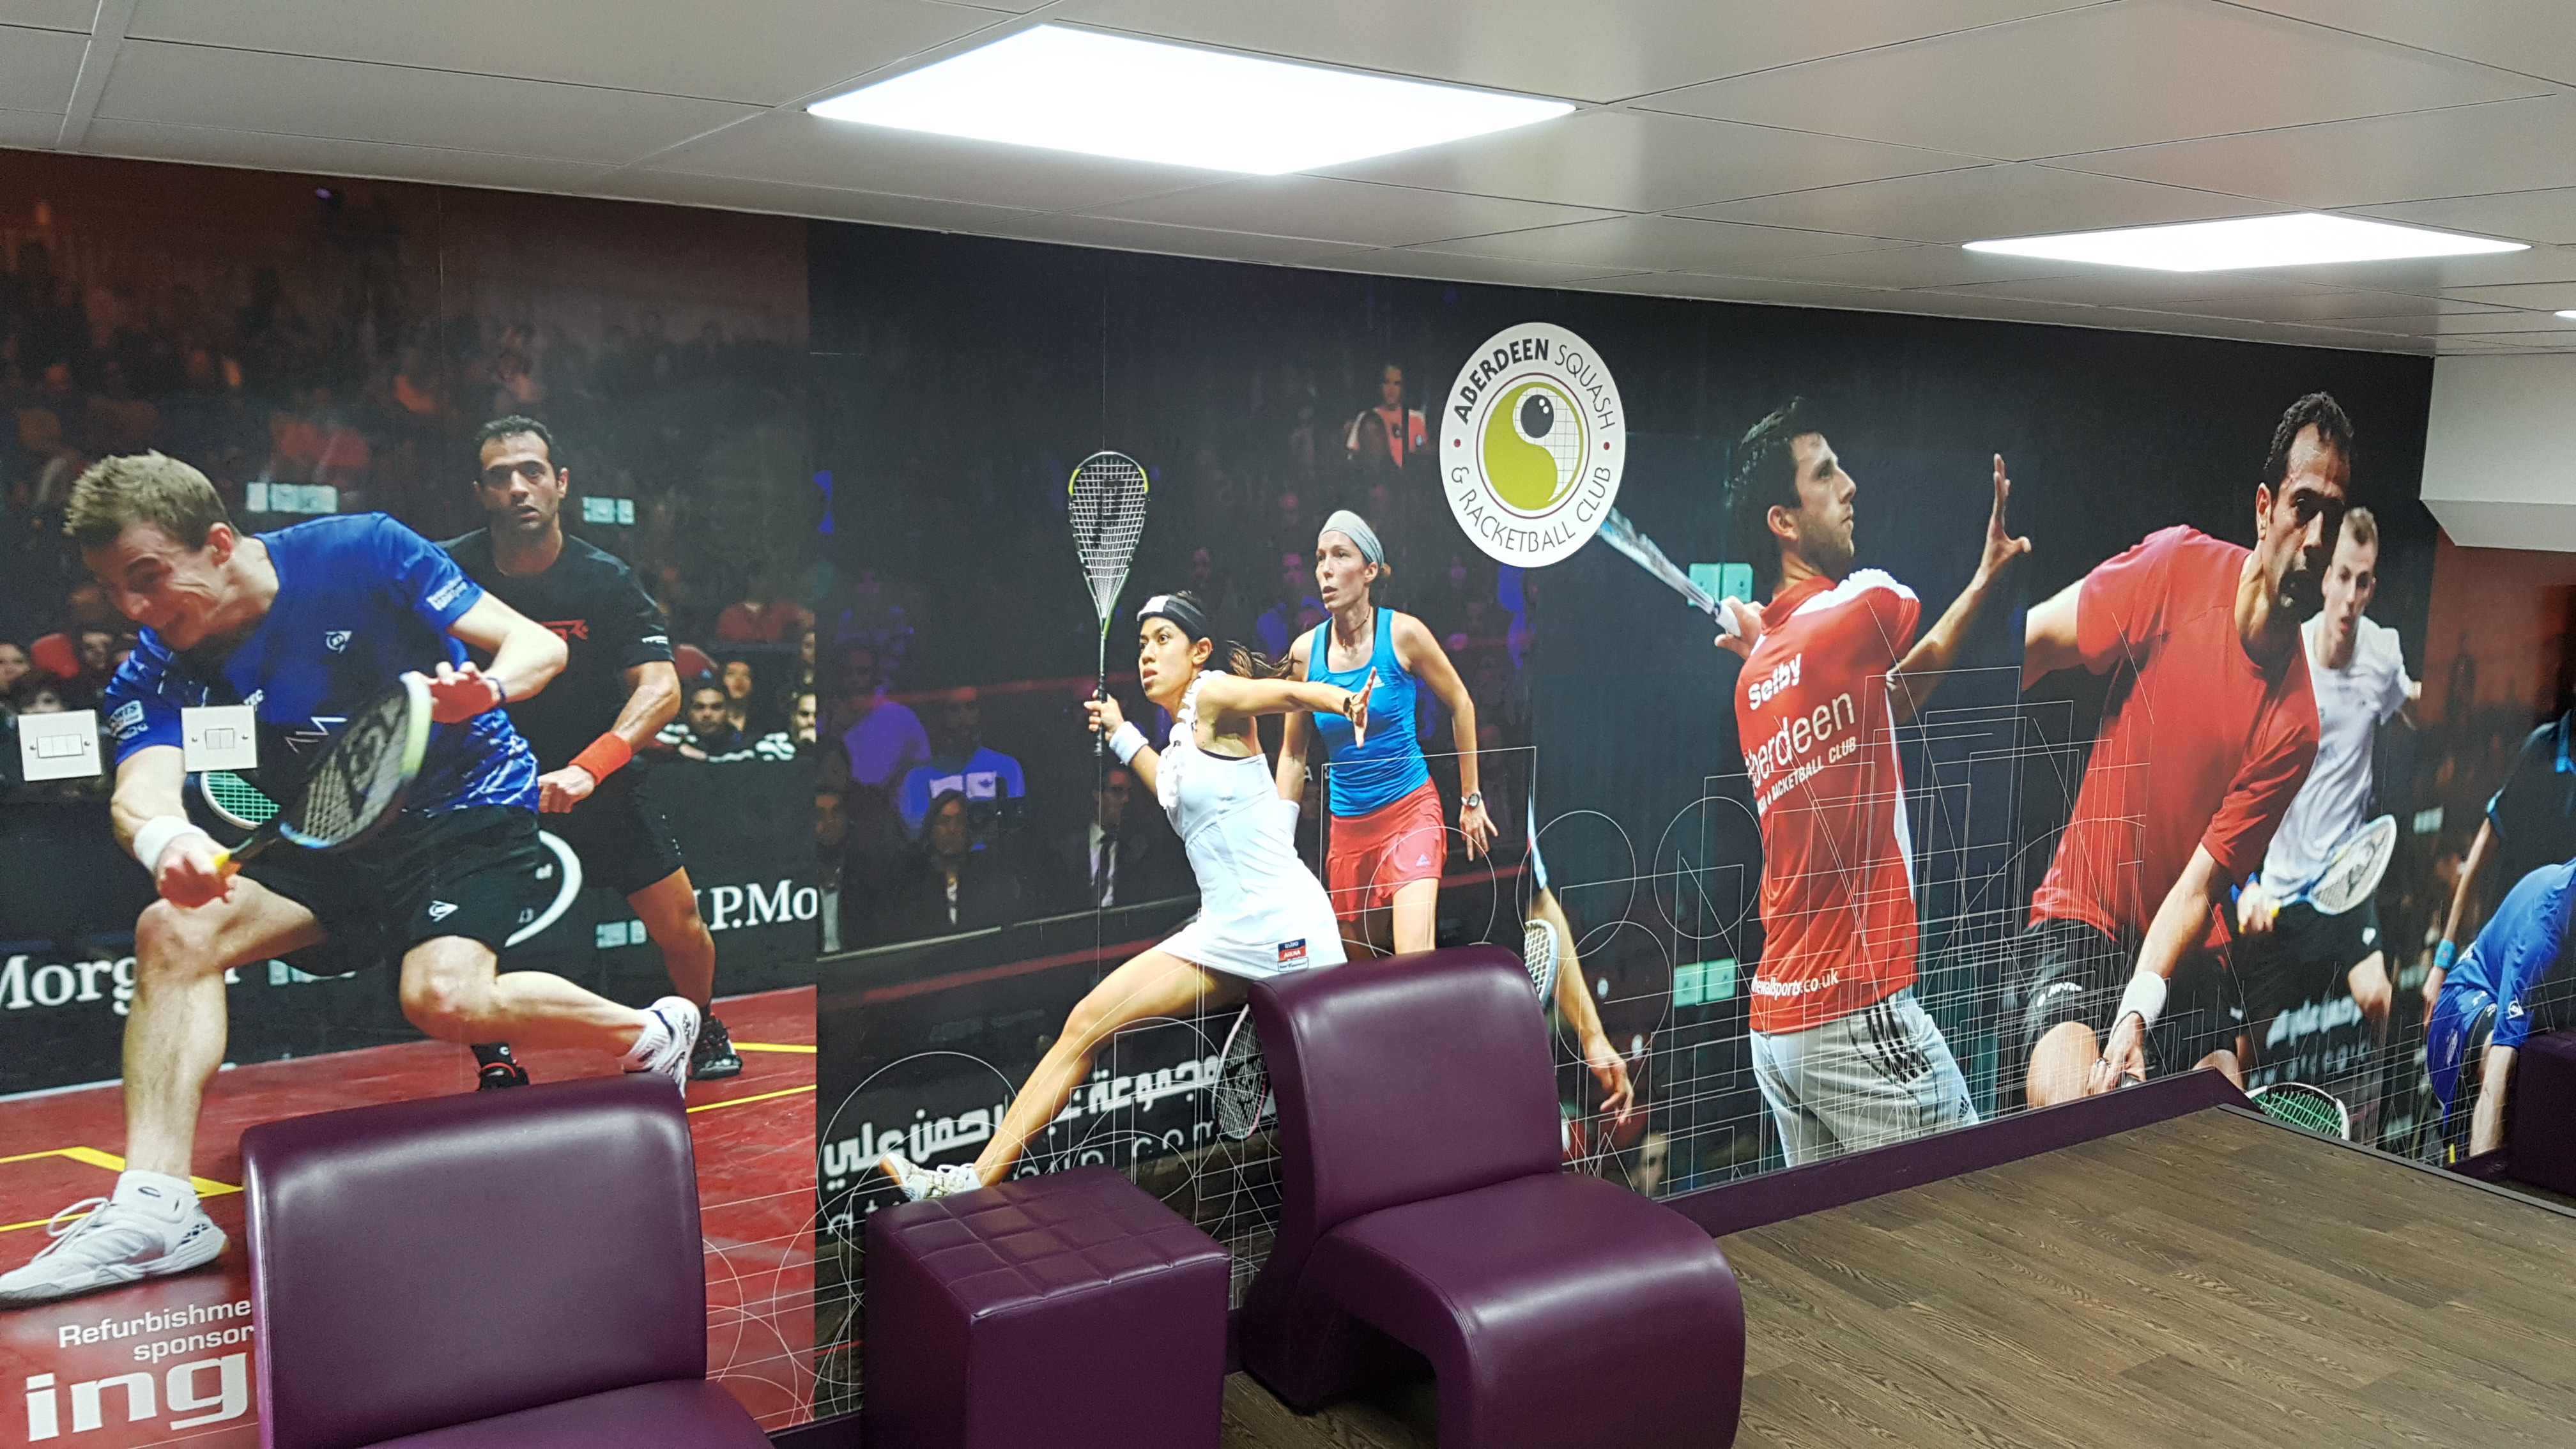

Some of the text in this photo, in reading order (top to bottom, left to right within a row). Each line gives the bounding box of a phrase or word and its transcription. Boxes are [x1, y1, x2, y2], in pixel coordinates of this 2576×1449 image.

[1453, 338, 1616, 430] ABERDEEN SQUASH
[1459, 489, 1576, 553] RACKETBALL
[1576, 466, 1611, 523] CLUB
[1748, 653, 1802, 710] Selby
[1828, 737, 1857, 763] CLUB
[58, 1300, 252, 1348] Refurbishme
[133, 1325, 256, 1364] sponsor
[26, 1353, 248, 1442] ing
